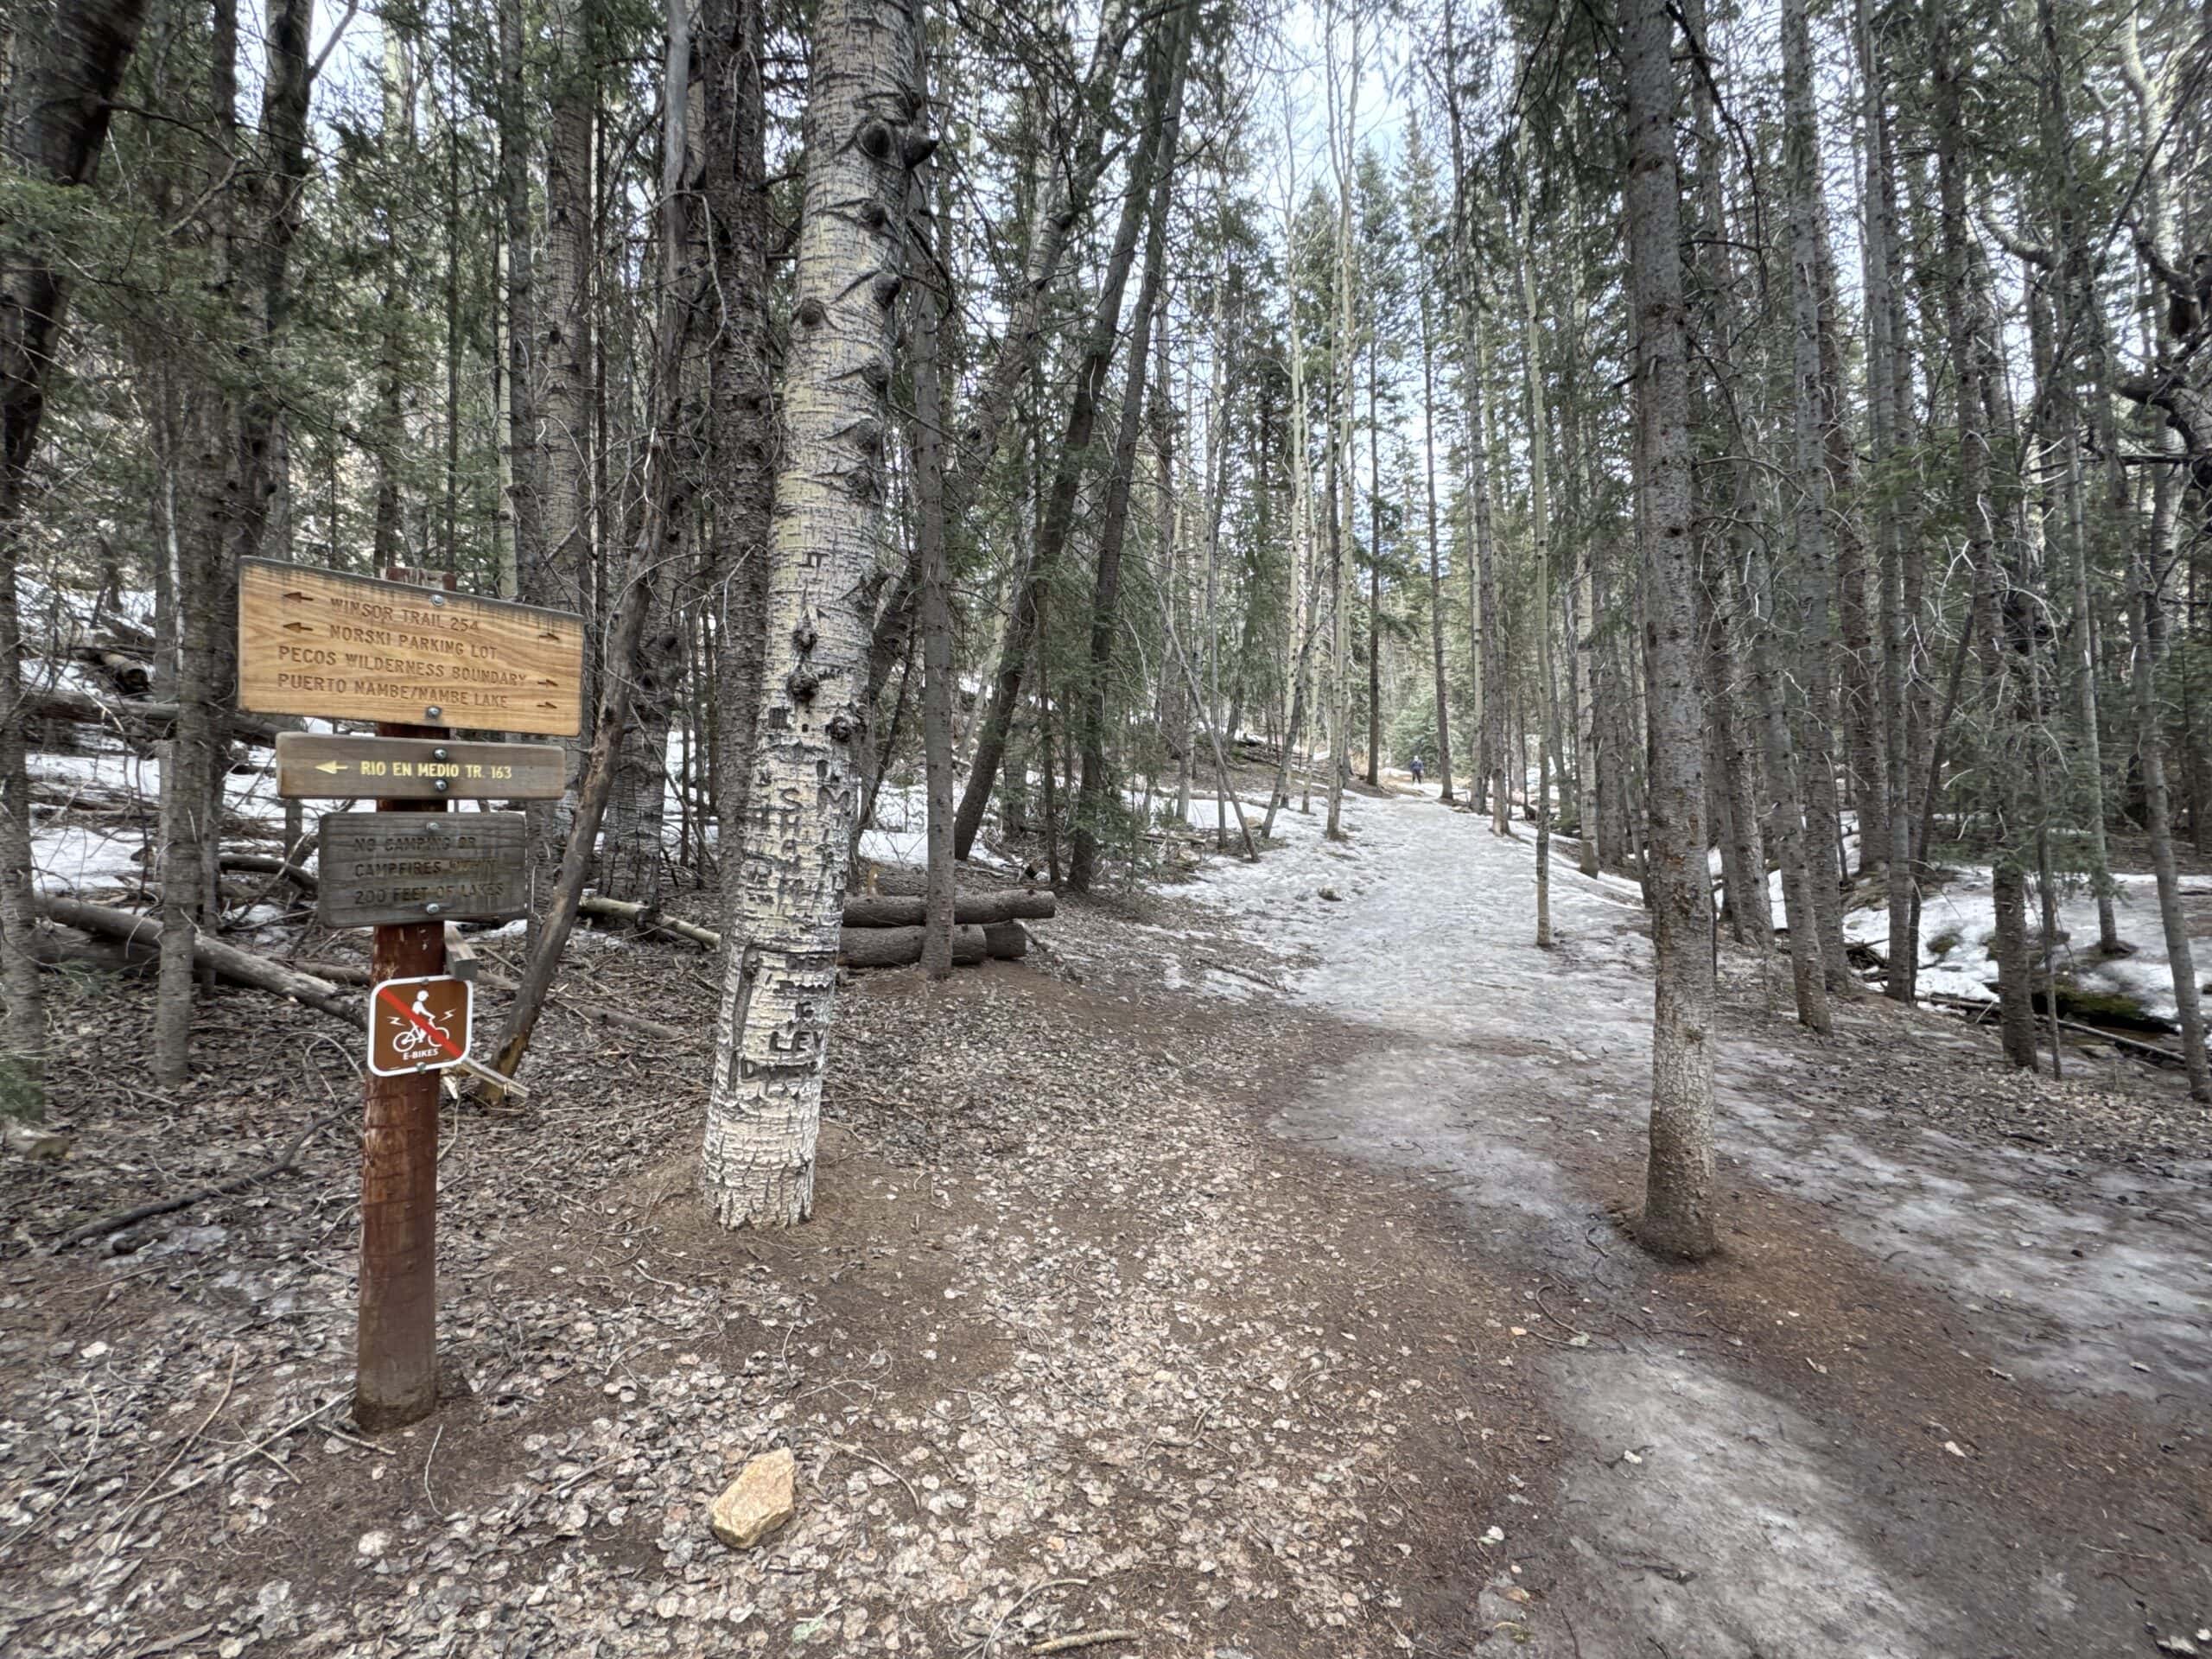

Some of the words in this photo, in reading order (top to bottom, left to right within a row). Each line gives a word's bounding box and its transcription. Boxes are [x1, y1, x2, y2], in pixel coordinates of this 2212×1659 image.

[330, 598, 394, 621] WINSOR
[401, 608, 445, 629] TRAIL
[450, 617, 480, 632] 254
[329, 625, 391, 645] NORSKI
[399, 634, 464, 656] PARKING
[471, 645, 498, 659] LOT
[278, 646, 337, 665] PECOS
[346, 653, 445, 678] WILDERNESS
[453, 662, 526, 687] BOUNDARY
[277, 673, 346, 693] PUERTO
[474, 693, 508, 709] LAKE
[360, 760, 386, 776] RIO
[393, 762, 412, 777] EN
[417, 763, 460, 778] MEDIO
[490, 766, 512, 779] 163
[385, 836, 451, 852] CAMPING
[354, 861, 442, 878] CAMPFIRES
[354, 888, 388, 905] 200
[393, 887, 429, 902] FEET
[436, 886, 454, 899] OF
[403, 1048, 439, 1061] E-BIKES
